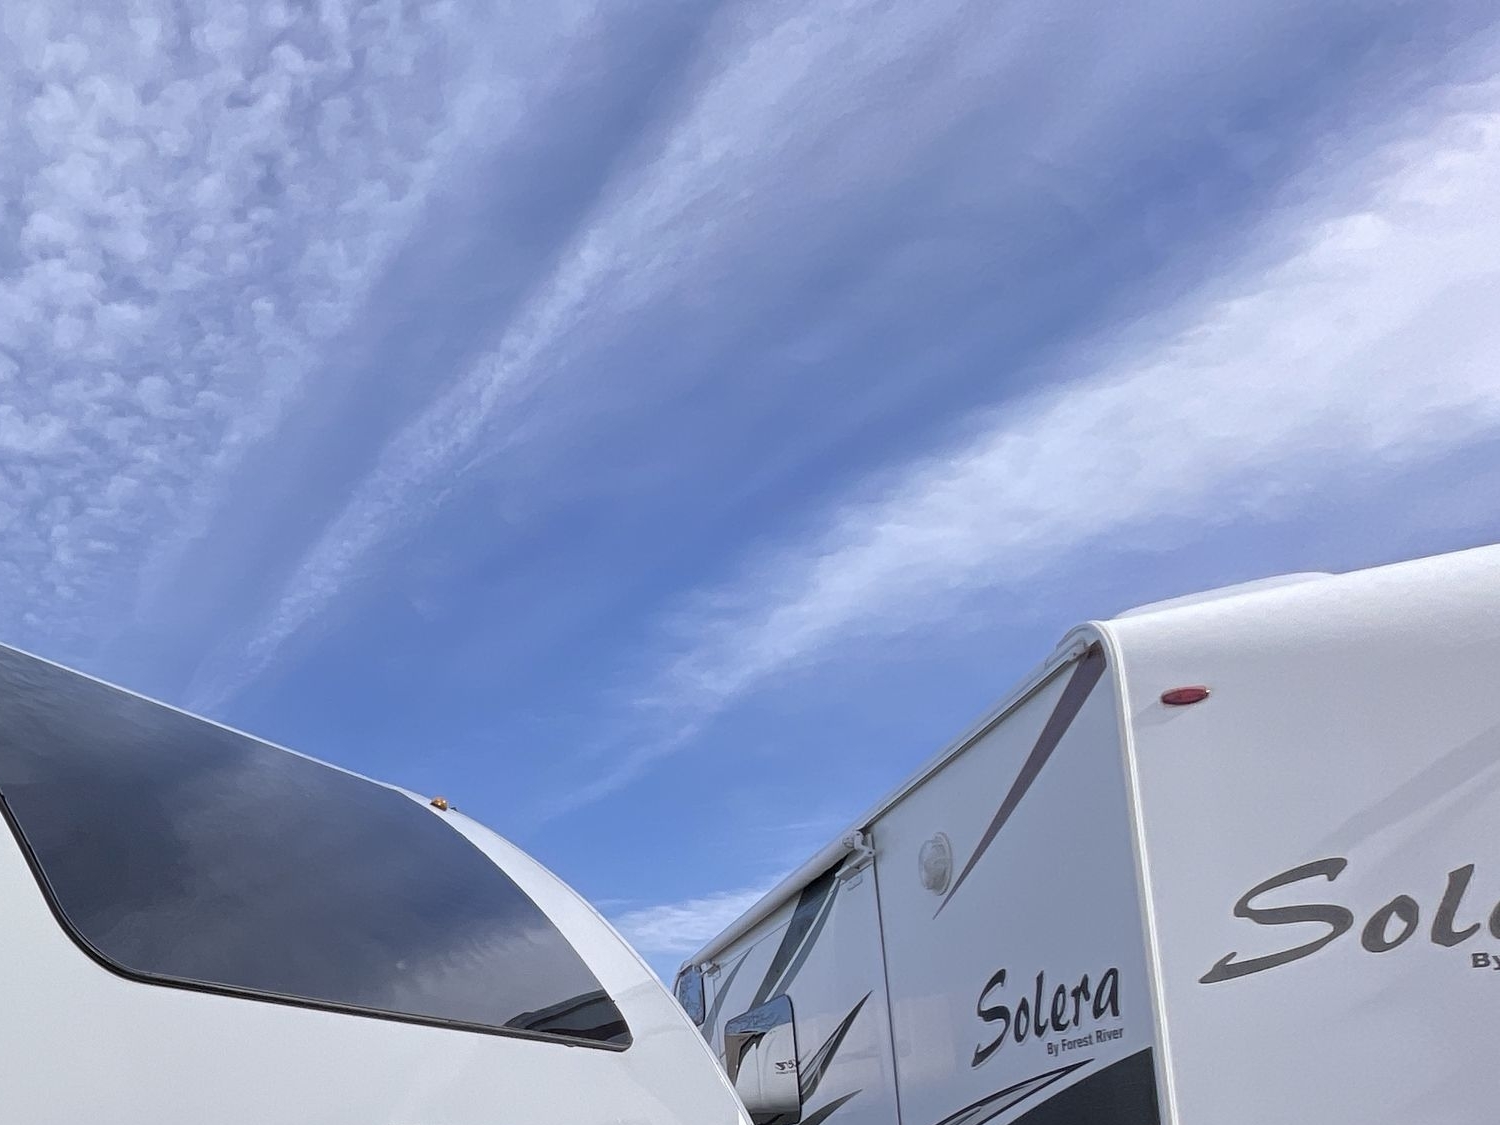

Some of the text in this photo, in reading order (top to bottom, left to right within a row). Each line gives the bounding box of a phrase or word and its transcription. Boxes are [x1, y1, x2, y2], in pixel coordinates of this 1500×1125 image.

[971, 968, 1120, 1067] Solera
[1047, 1027, 1124, 1057] By Forest River
